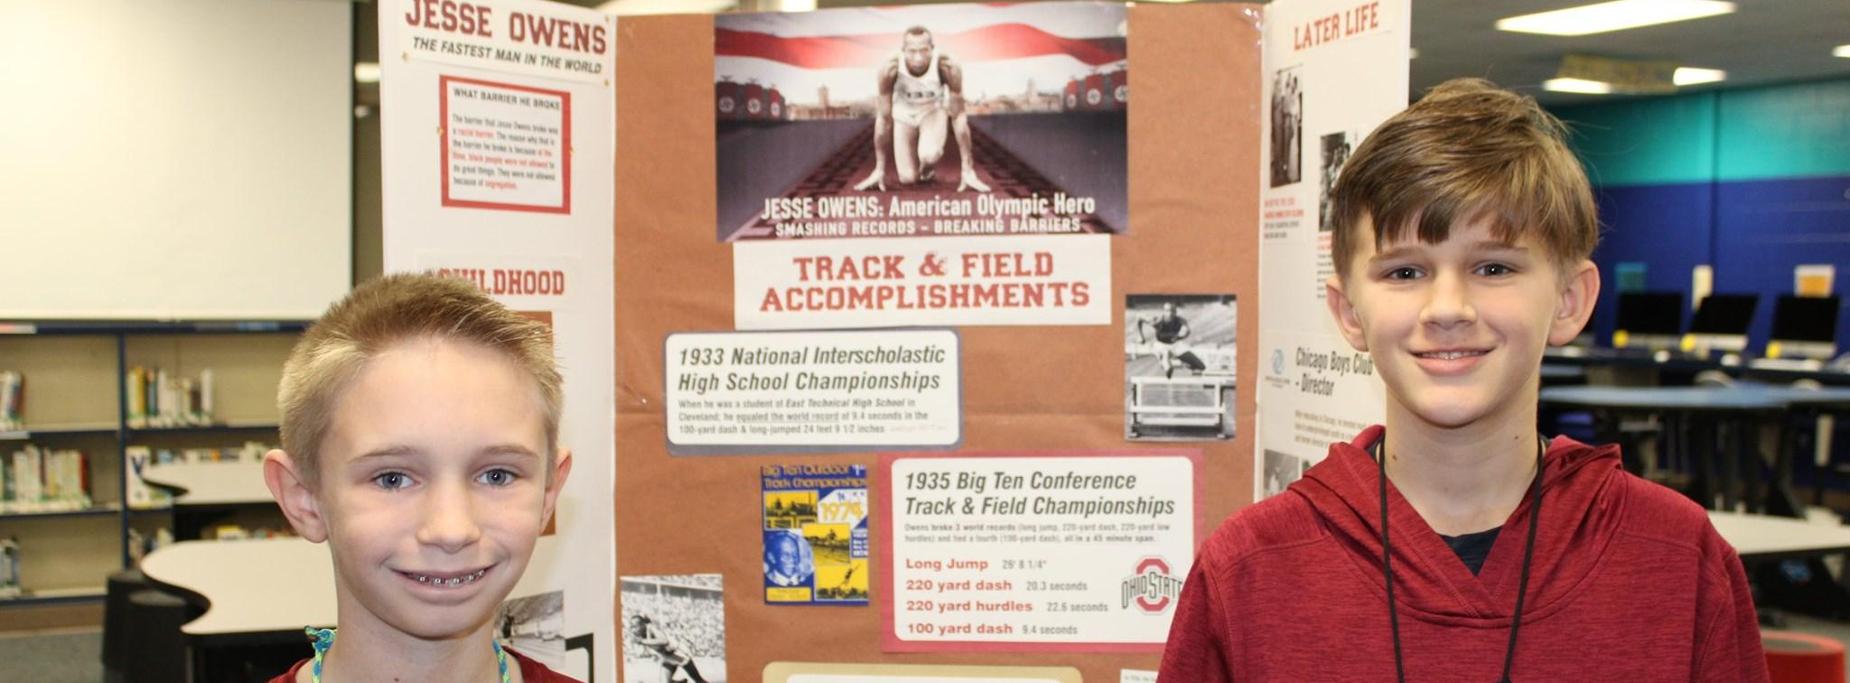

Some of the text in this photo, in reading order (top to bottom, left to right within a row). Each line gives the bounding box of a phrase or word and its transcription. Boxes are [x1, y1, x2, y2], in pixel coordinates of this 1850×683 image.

[405, 0, 606, 54] JESSE OWENS
[1294, 2, 1379, 50] LATER LIFE
[413, 37, 602, 74] THE FASTEST MAN IN THE WORLD
[454, 88, 560, 110] WHAT BARRIER HE BROKE
[762, 192, 1095, 221] JESSE OWENS: American Olympic Hero
[776, 224, 846, 236] SMASHING
[852, 222, 915, 235] RECORDS
[934, 220, 1003, 234] BREAKING
[1010, 218, 1080, 232] BARRIERS
[793, 252, 1054, 281] TRACK & FIELD
[439, 269, 564, 295] LDHOOD
[759, 282, 1090, 312] ACCOMPLISHMENTS
[679, 345, 945, 366] 1933 National Interscholastic
[1296, 347, 1373, 376] Chicago Boys Club
[678, 371, 940, 395] High School Championships
[1302, 374, 1334, 396] Director
[905, 472, 1136, 493] 1935 Big Ten Conference
[905, 496, 1174, 518] Track & Field Championships
[906, 559, 942, 572] Long
[947, 558, 988, 572] Jump
[906, 580, 1088, 594] 220 yard dash 20.3 seconds
[1121, 575, 1147, 610] OHIO
[906, 601, 934, 612] 220
[938, 601, 970, 614] yard
[976, 600, 1032, 612] hurdles
[1070, 602, 1108, 612] seconds
[908, 624, 1078, 636] 100 yard dash 9.4 seconds
